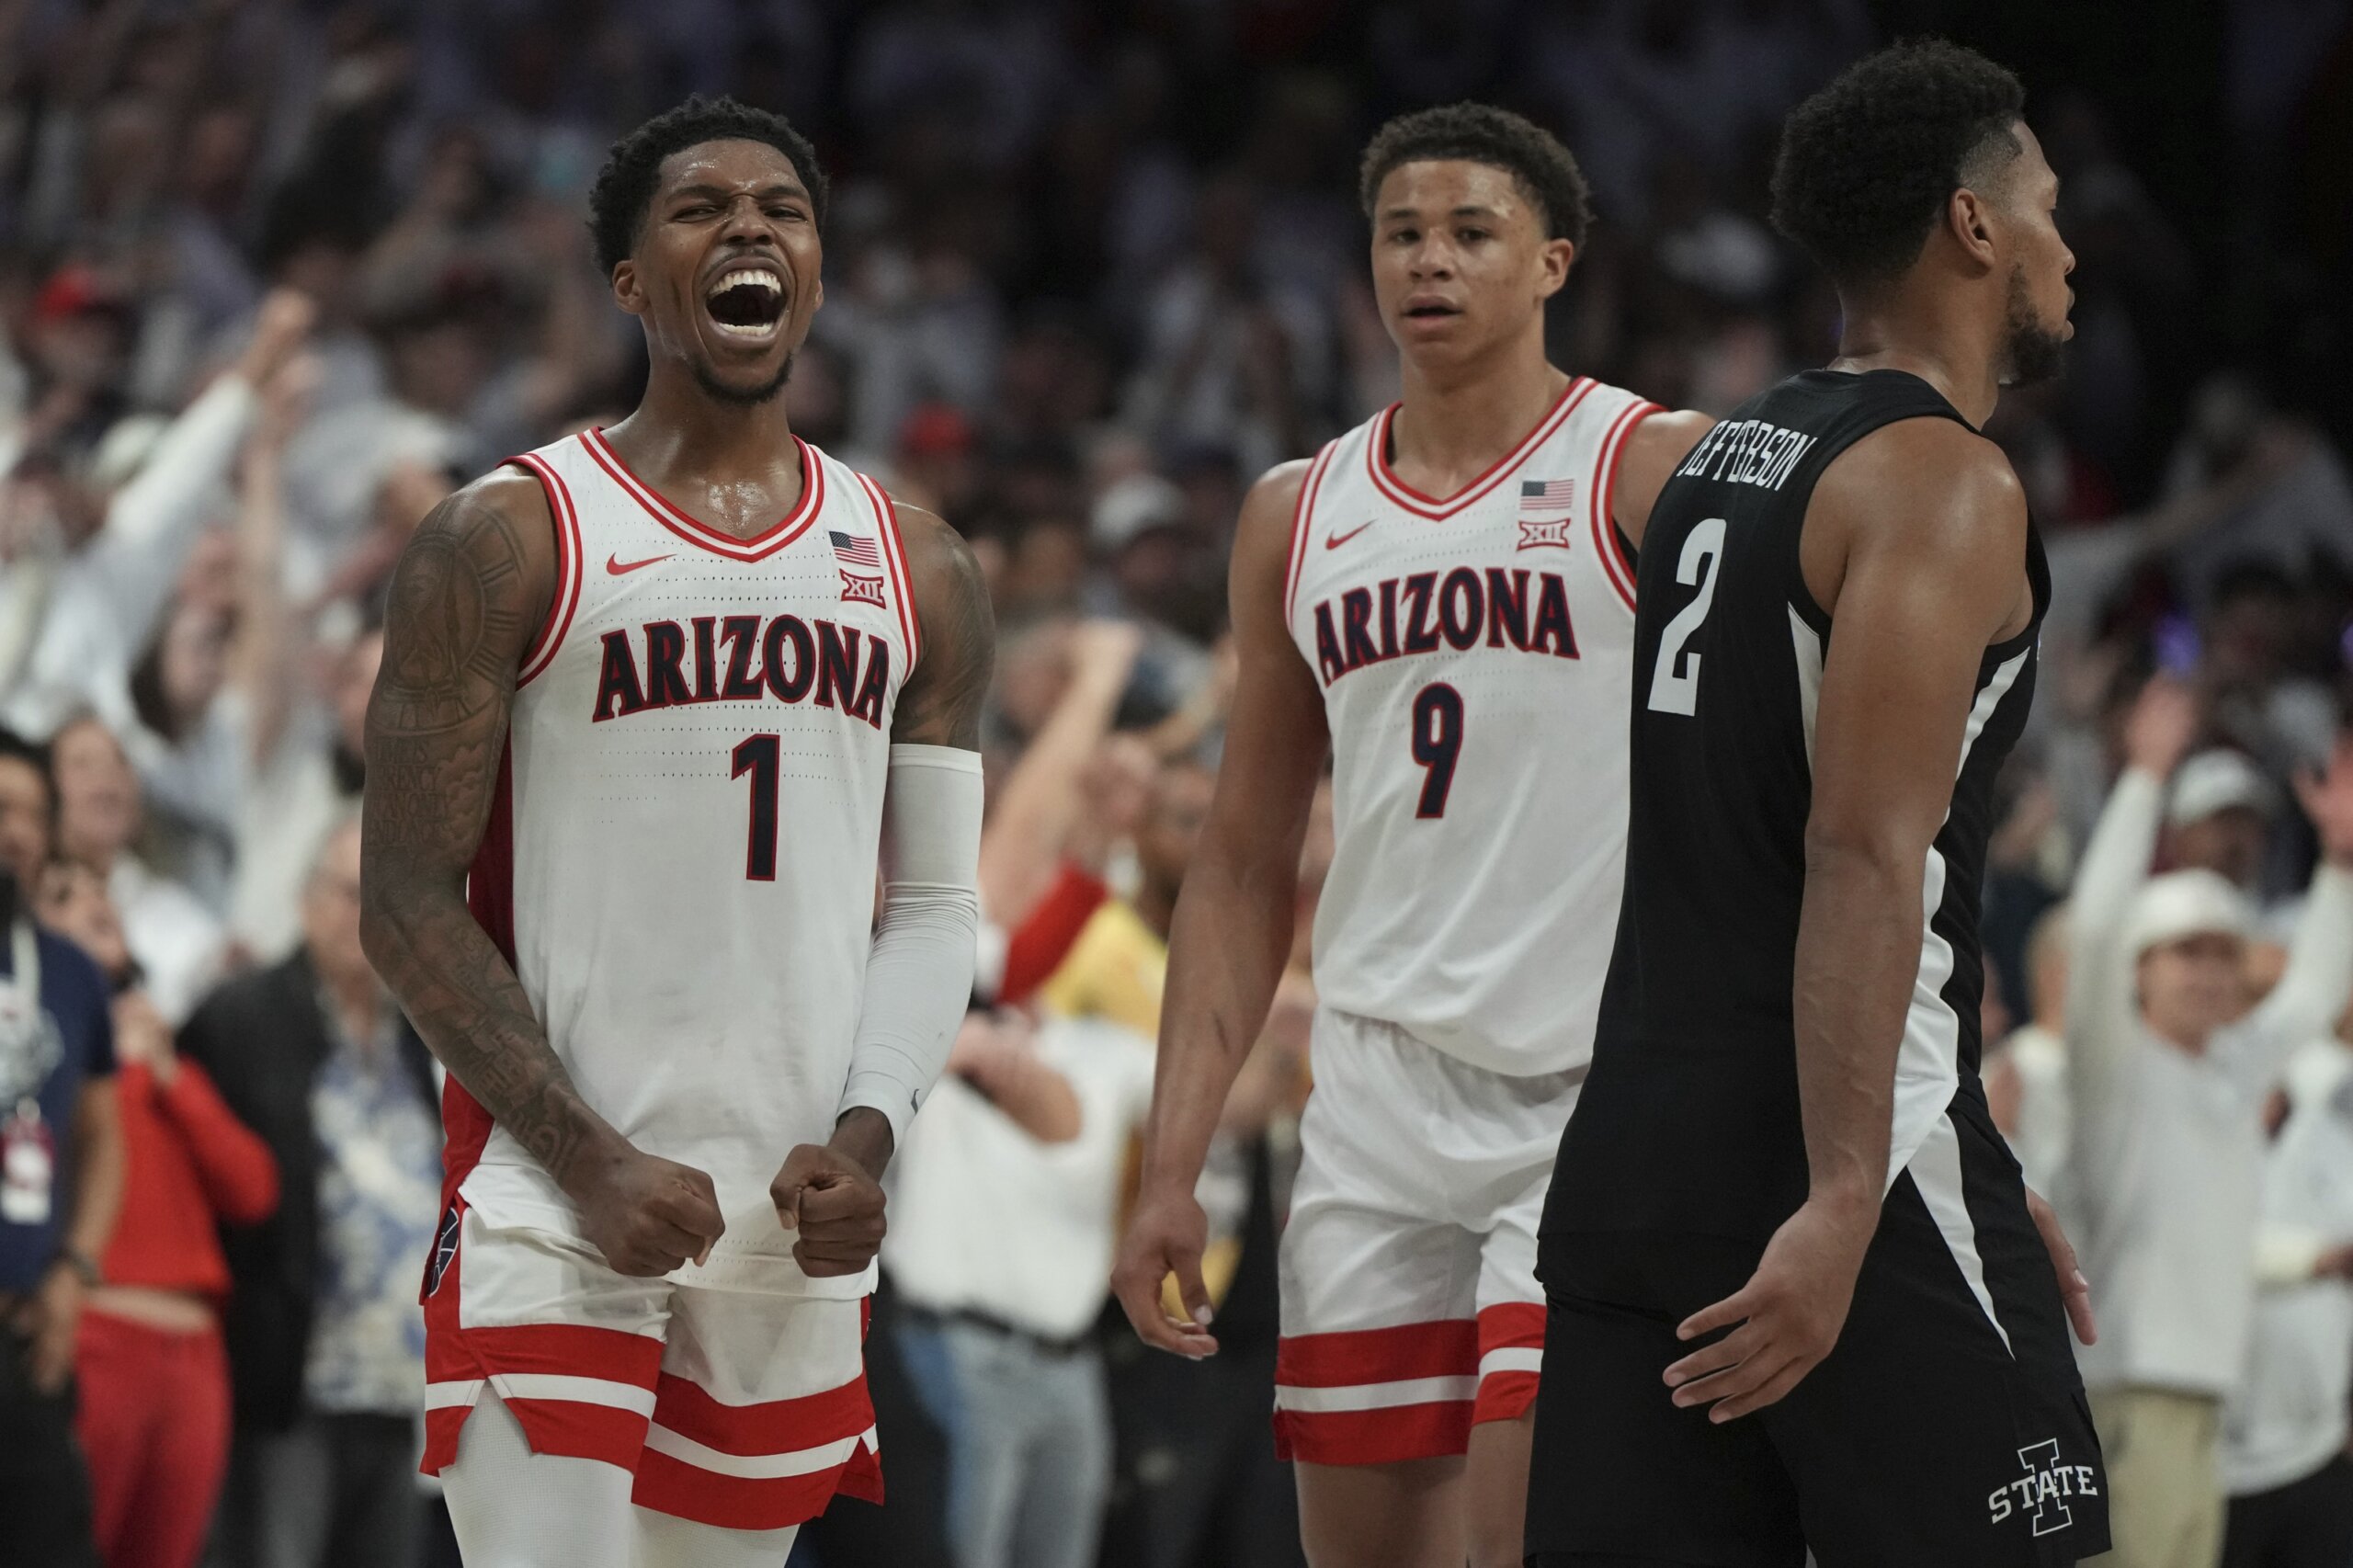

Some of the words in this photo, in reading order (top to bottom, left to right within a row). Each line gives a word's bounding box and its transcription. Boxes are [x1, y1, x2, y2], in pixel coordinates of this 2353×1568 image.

[1676, 419, 1819, 492] JEFFERSON
[840, 571, 885, 607] XII
[1518, 519, 1570, 549] XII
[592, 614, 890, 731] ARIZONA
[1313, 565, 1581, 688] ARIZONA
[1647, 517, 1727, 717] 2
[731, 733, 780, 881] 1
[1412, 681, 1464, 819] 9
[1988, 1465, 2098, 1525] STATE
